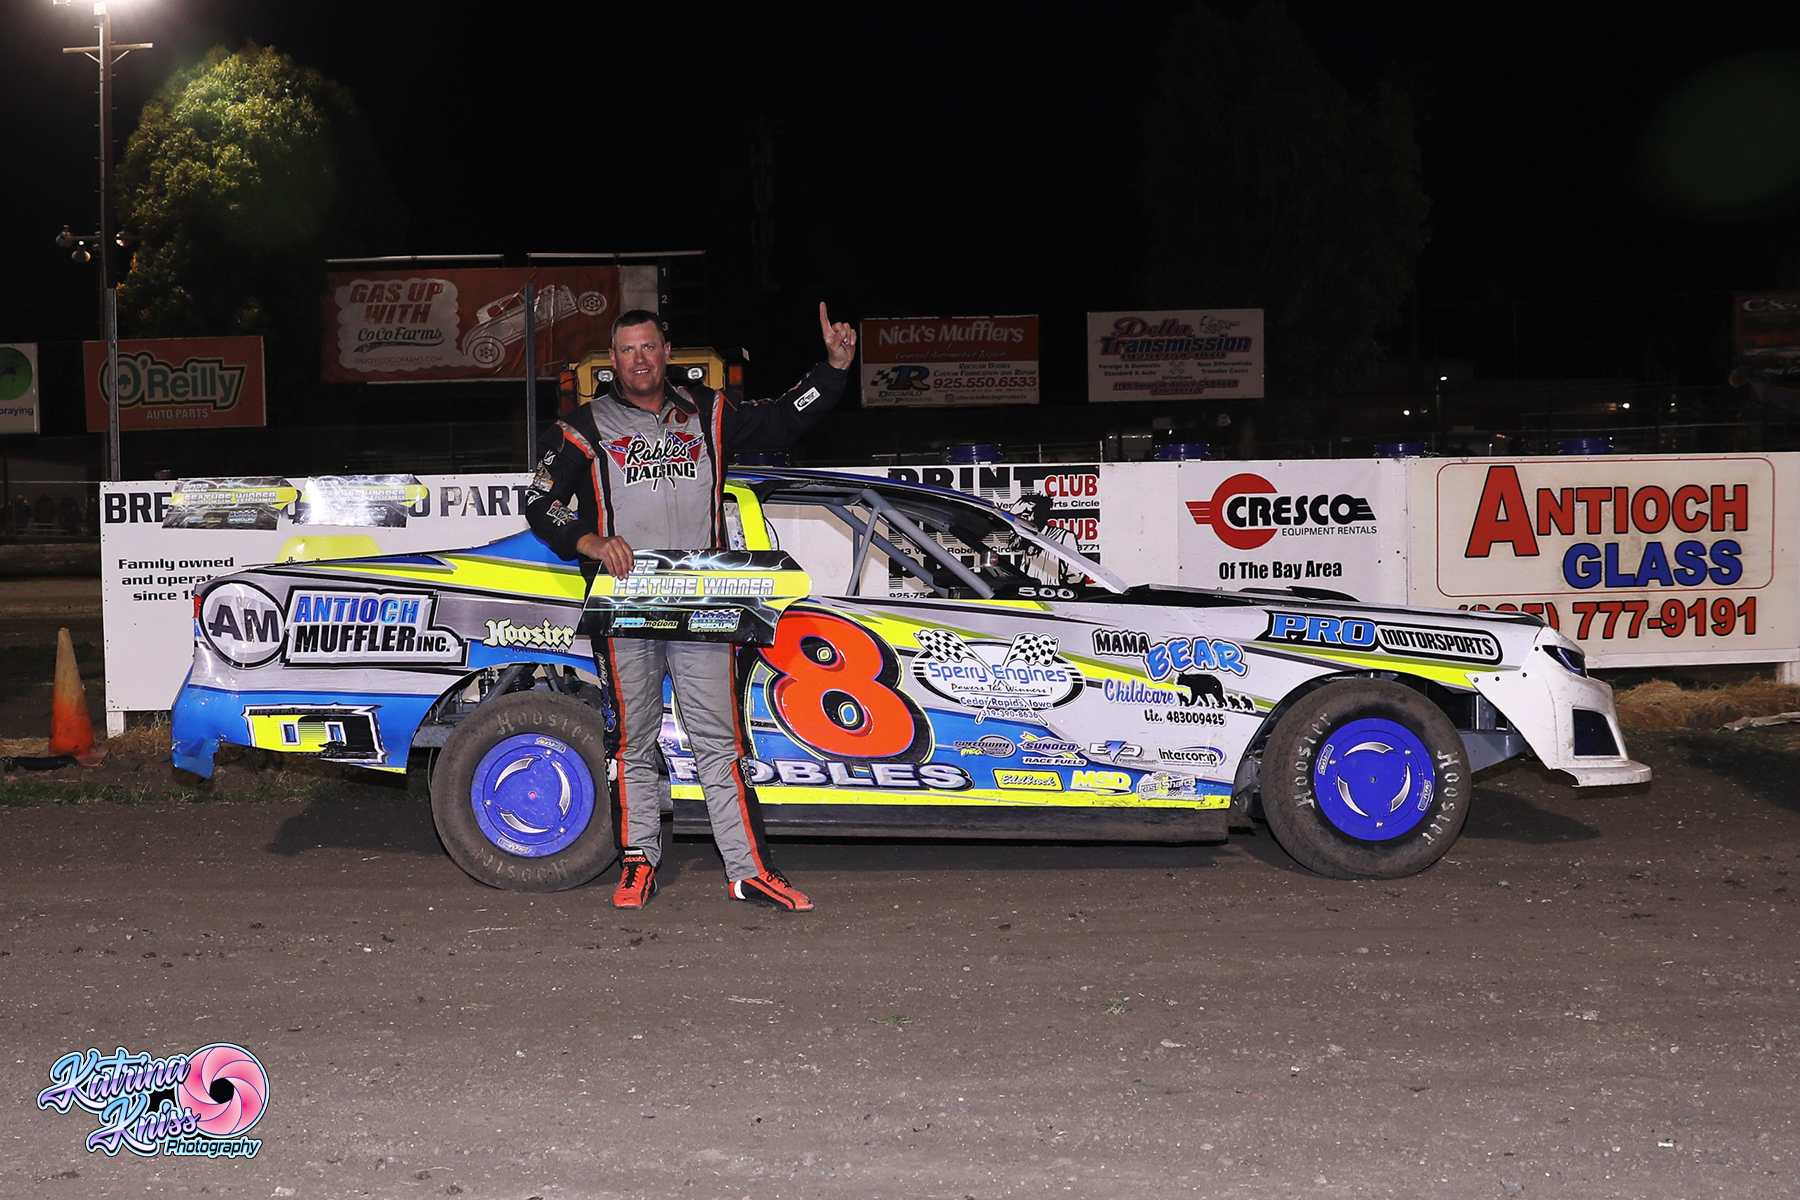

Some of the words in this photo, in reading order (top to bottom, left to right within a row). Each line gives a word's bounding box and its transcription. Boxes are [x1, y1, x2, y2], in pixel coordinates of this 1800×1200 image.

[661, 267, 667, 277] 1
[350, 283, 402, 303] GAS
[408, 283, 444, 302] UP
[661, 295, 668, 304] 2
[364, 304, 431, 324] WITH
[662, 322, 668, 331] 3
[879, 324, 935, 345] Nick's
[938, 321, 1024, 342] Mufflers
[1112, 317, 1193, 337] Delta
[1101, 334, 1252, 354] Transmission
[110, 358, 236, 401] O'Reilly
[933, 377, 1037, 389] 925.550.6533
[146, 409, 172, 419] AUTO
[176, 408, 208, 418] PARTS
[627, 439, 688, 464] Robles
[626, 463, 696, 484] RACING
[1045, 475, 1098, 497] CLUB
[184, 494, 232, 503] FEATURE
[235, 492, 277, 502] WINNER
[440, 486, 528, 517] PART
[1227, 494, 1368, 527] CRESCO
[1465, 464, 1748, 558] ANTIOCH
[1282, 526, 1335, 536] EQUIPMENT
[1337, 525, 1377, 535] RENTALS
[118, 558, 175, 571] Family
[178, 557, 234, 568] owned
[1219, 562, 1236, 579] Of
[1239, 562, 1268, 579] The
[1273, 561, 1301, 579] Bay
[1305, 560, 1342, 577] Area
[1562, 540, 1743, 589] GLASS
[121, 574, 153, 585] and
[157, 575, 220, 586] operat
[614, 577, 697, 595] FEATURE
[702, 577, 774, 595] WINNER
[133, 590, 177, 601] since
[1018, 587, 1075, 599] 500
[294, 596, 420, 624] ANTIOCH
[1572, 597, 1757, 640] 777-9191
[208, 604, 280, 643] AM
[483, 618, 575, 649] Hoosier
[1269, 612, 1378, 647] PRO
[294, 625, 416, 652] MUFFLER
[417, 636, 450, 652] INC.
[1381, 627, 1495, 656] MOTORSPORTS
[1096, 632, 1150, 654] MAMA
[1147, 639, 1247, 678] BEAR
[757, 608, 916, 758] 8
[928, 663, 988, 682] Sperry
[991, 664, 1068, 684] Engines
[1104, 679, 1175, 704] Childcare
[960, 697, 988, 705] Cedar
[991, 697, 1028, 708] Rapids,
[1030, 699, 1053, 708] Iowa
[982, 709, 1039, 718] 319-390-8636
[1144, 709, 1163, 722] Lic.
[1166, 710, 1225, 725] 483009425
[1025, 741, 1077, 751] SUNOCO
[1159, 748, 1217, 765] Intercomp
[1002, 773, 1057, 787] Edelbrock
[1073, 771, 1131, 788] MSD
